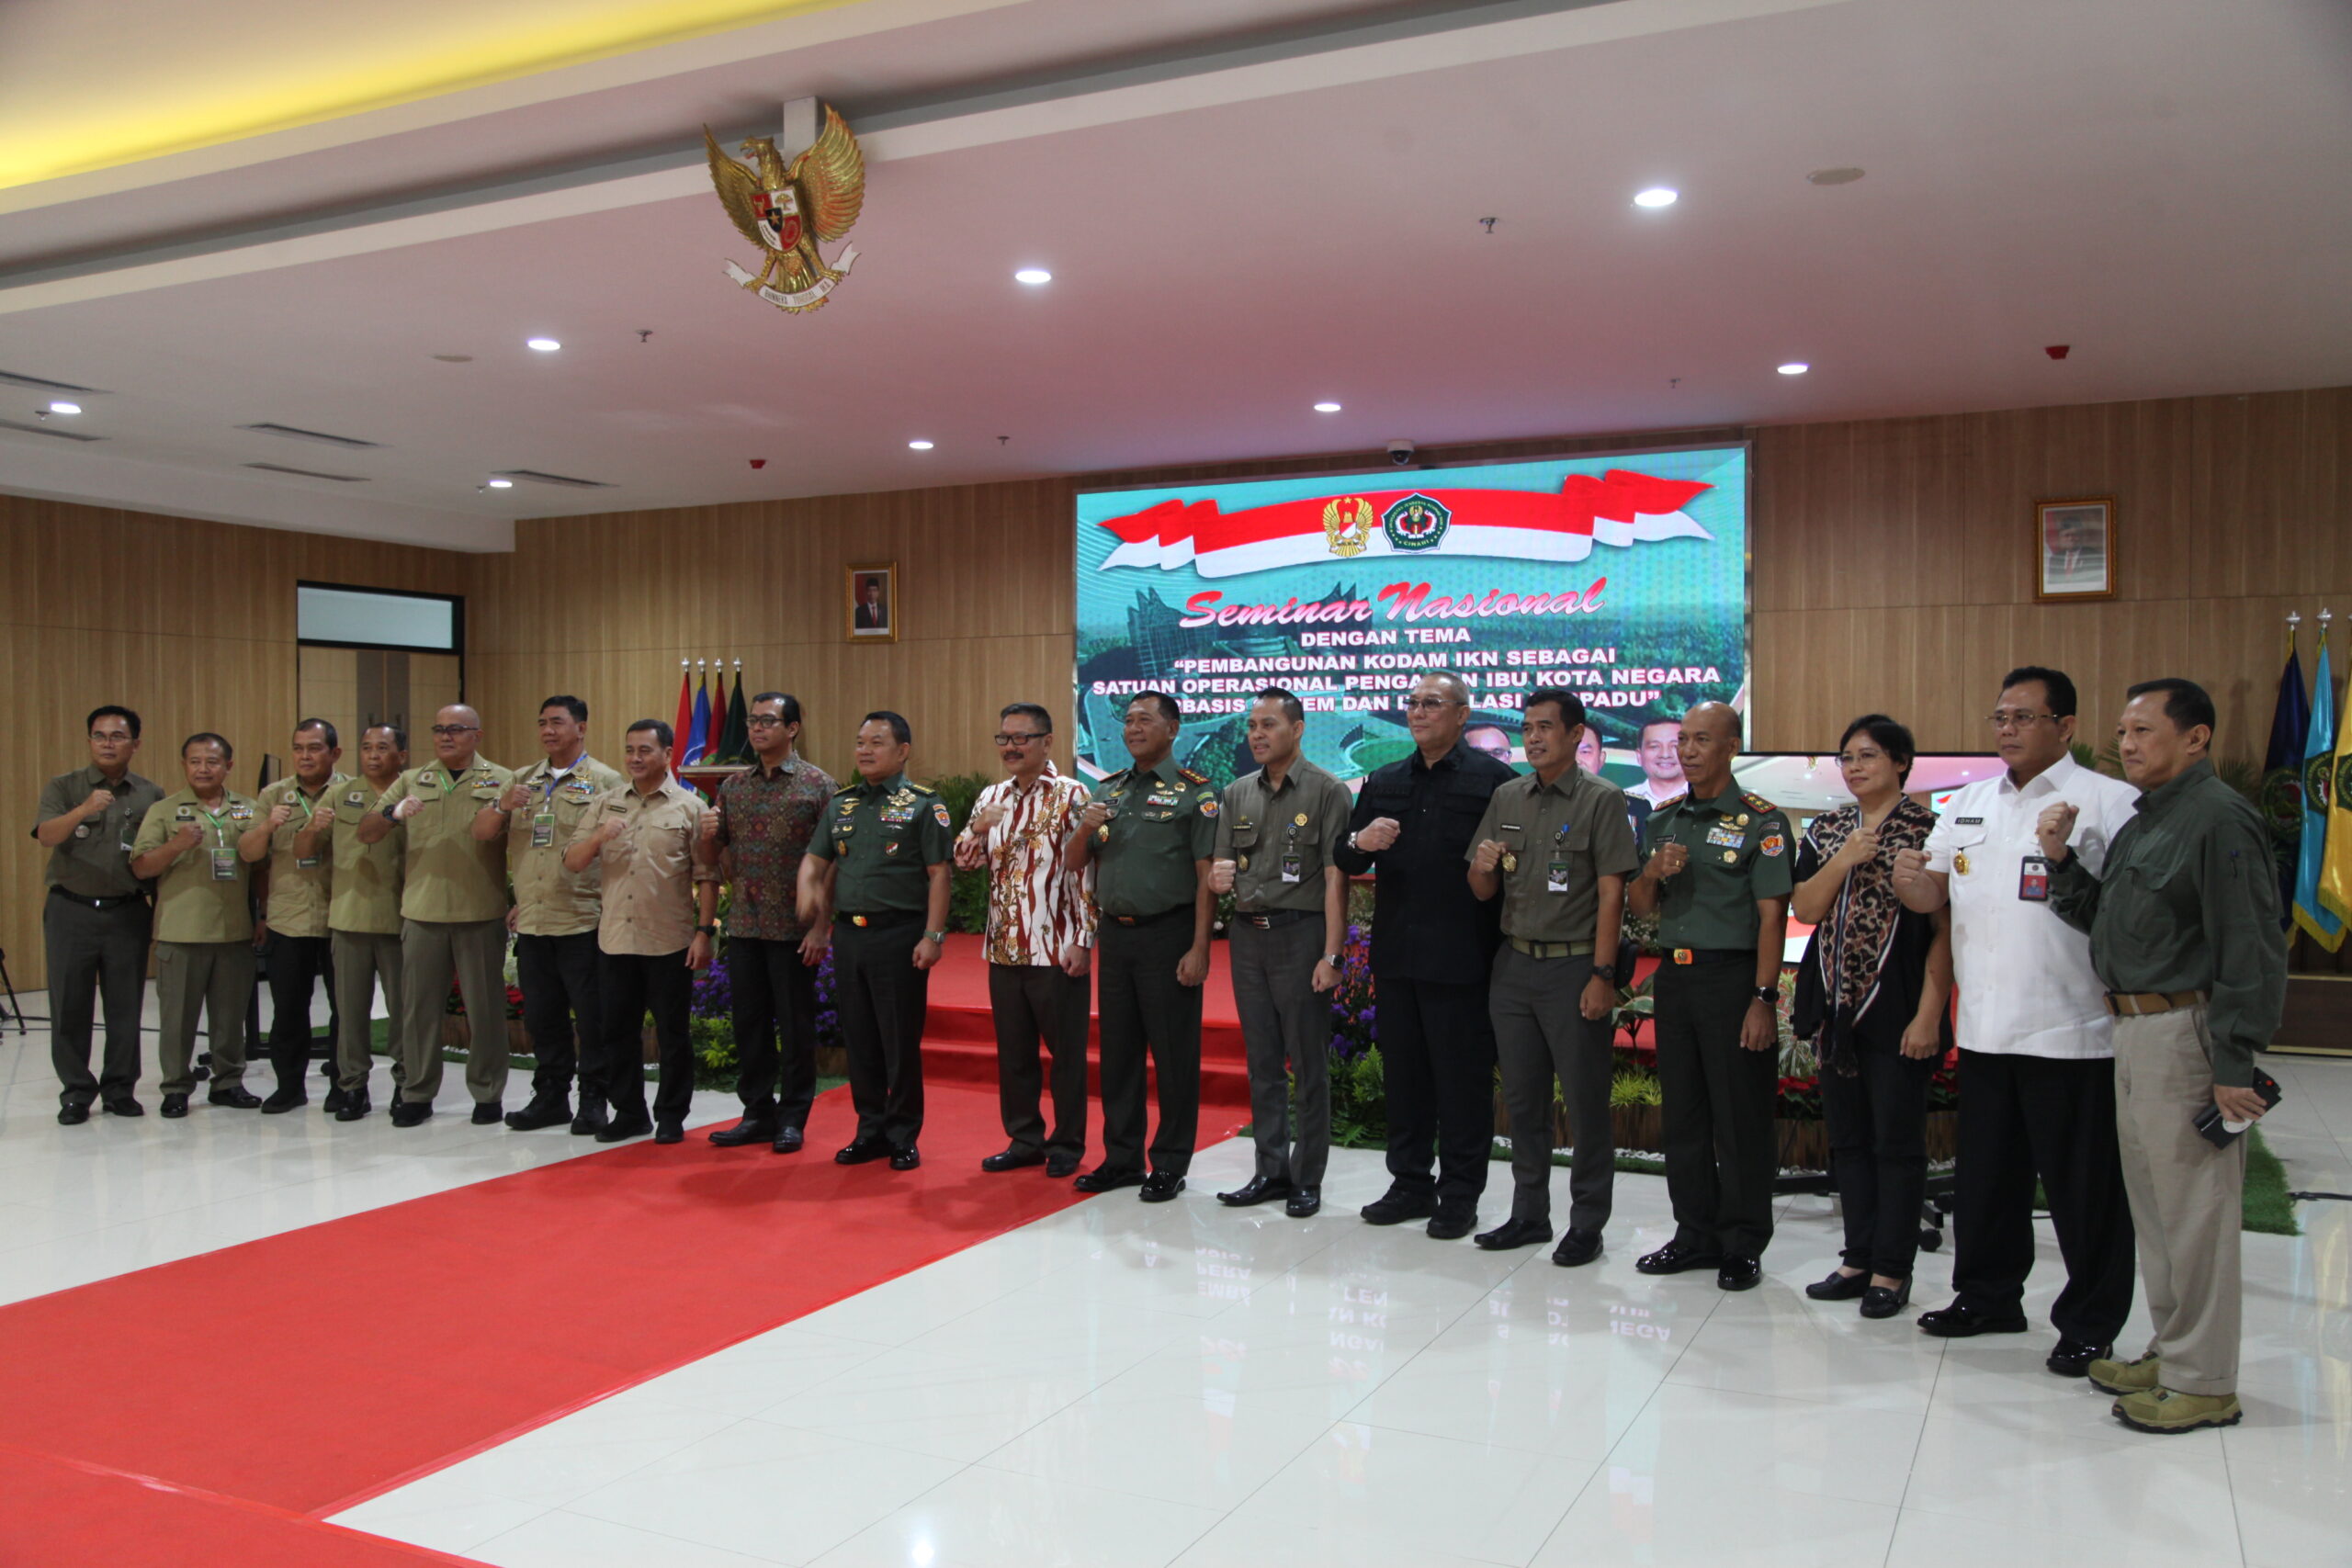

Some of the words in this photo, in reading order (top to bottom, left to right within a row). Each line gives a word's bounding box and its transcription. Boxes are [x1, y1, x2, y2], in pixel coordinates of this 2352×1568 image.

[1179, 591, 1373, 627] Seminar
[1377, 577, 1607, 622] Nasional
[1301, 630, 1397, 647] DENGAN
[1405, 627, 1471, 644] TEMA
[1174, 655, 1355, 673] “PEMBANGUNAN
[1363, 652, 1447, 670] KODAM
[1455, 651, 1498, 667] IKN
[1506, 648, 1616, 665] SEBAGAI
[1092, 680, 1176, 694] SATUAN
[1182, 676, 1338, 694] OPERASIONAL
[1345, 672, 1478, 690] PENGAN
[1486, 671, 1528, 688] IBU
[1536, 670, 1603, 686] KOTA
[1611, 667, 1720, 684] NEGARA
[1342, 695, 1389, 711] DAN
